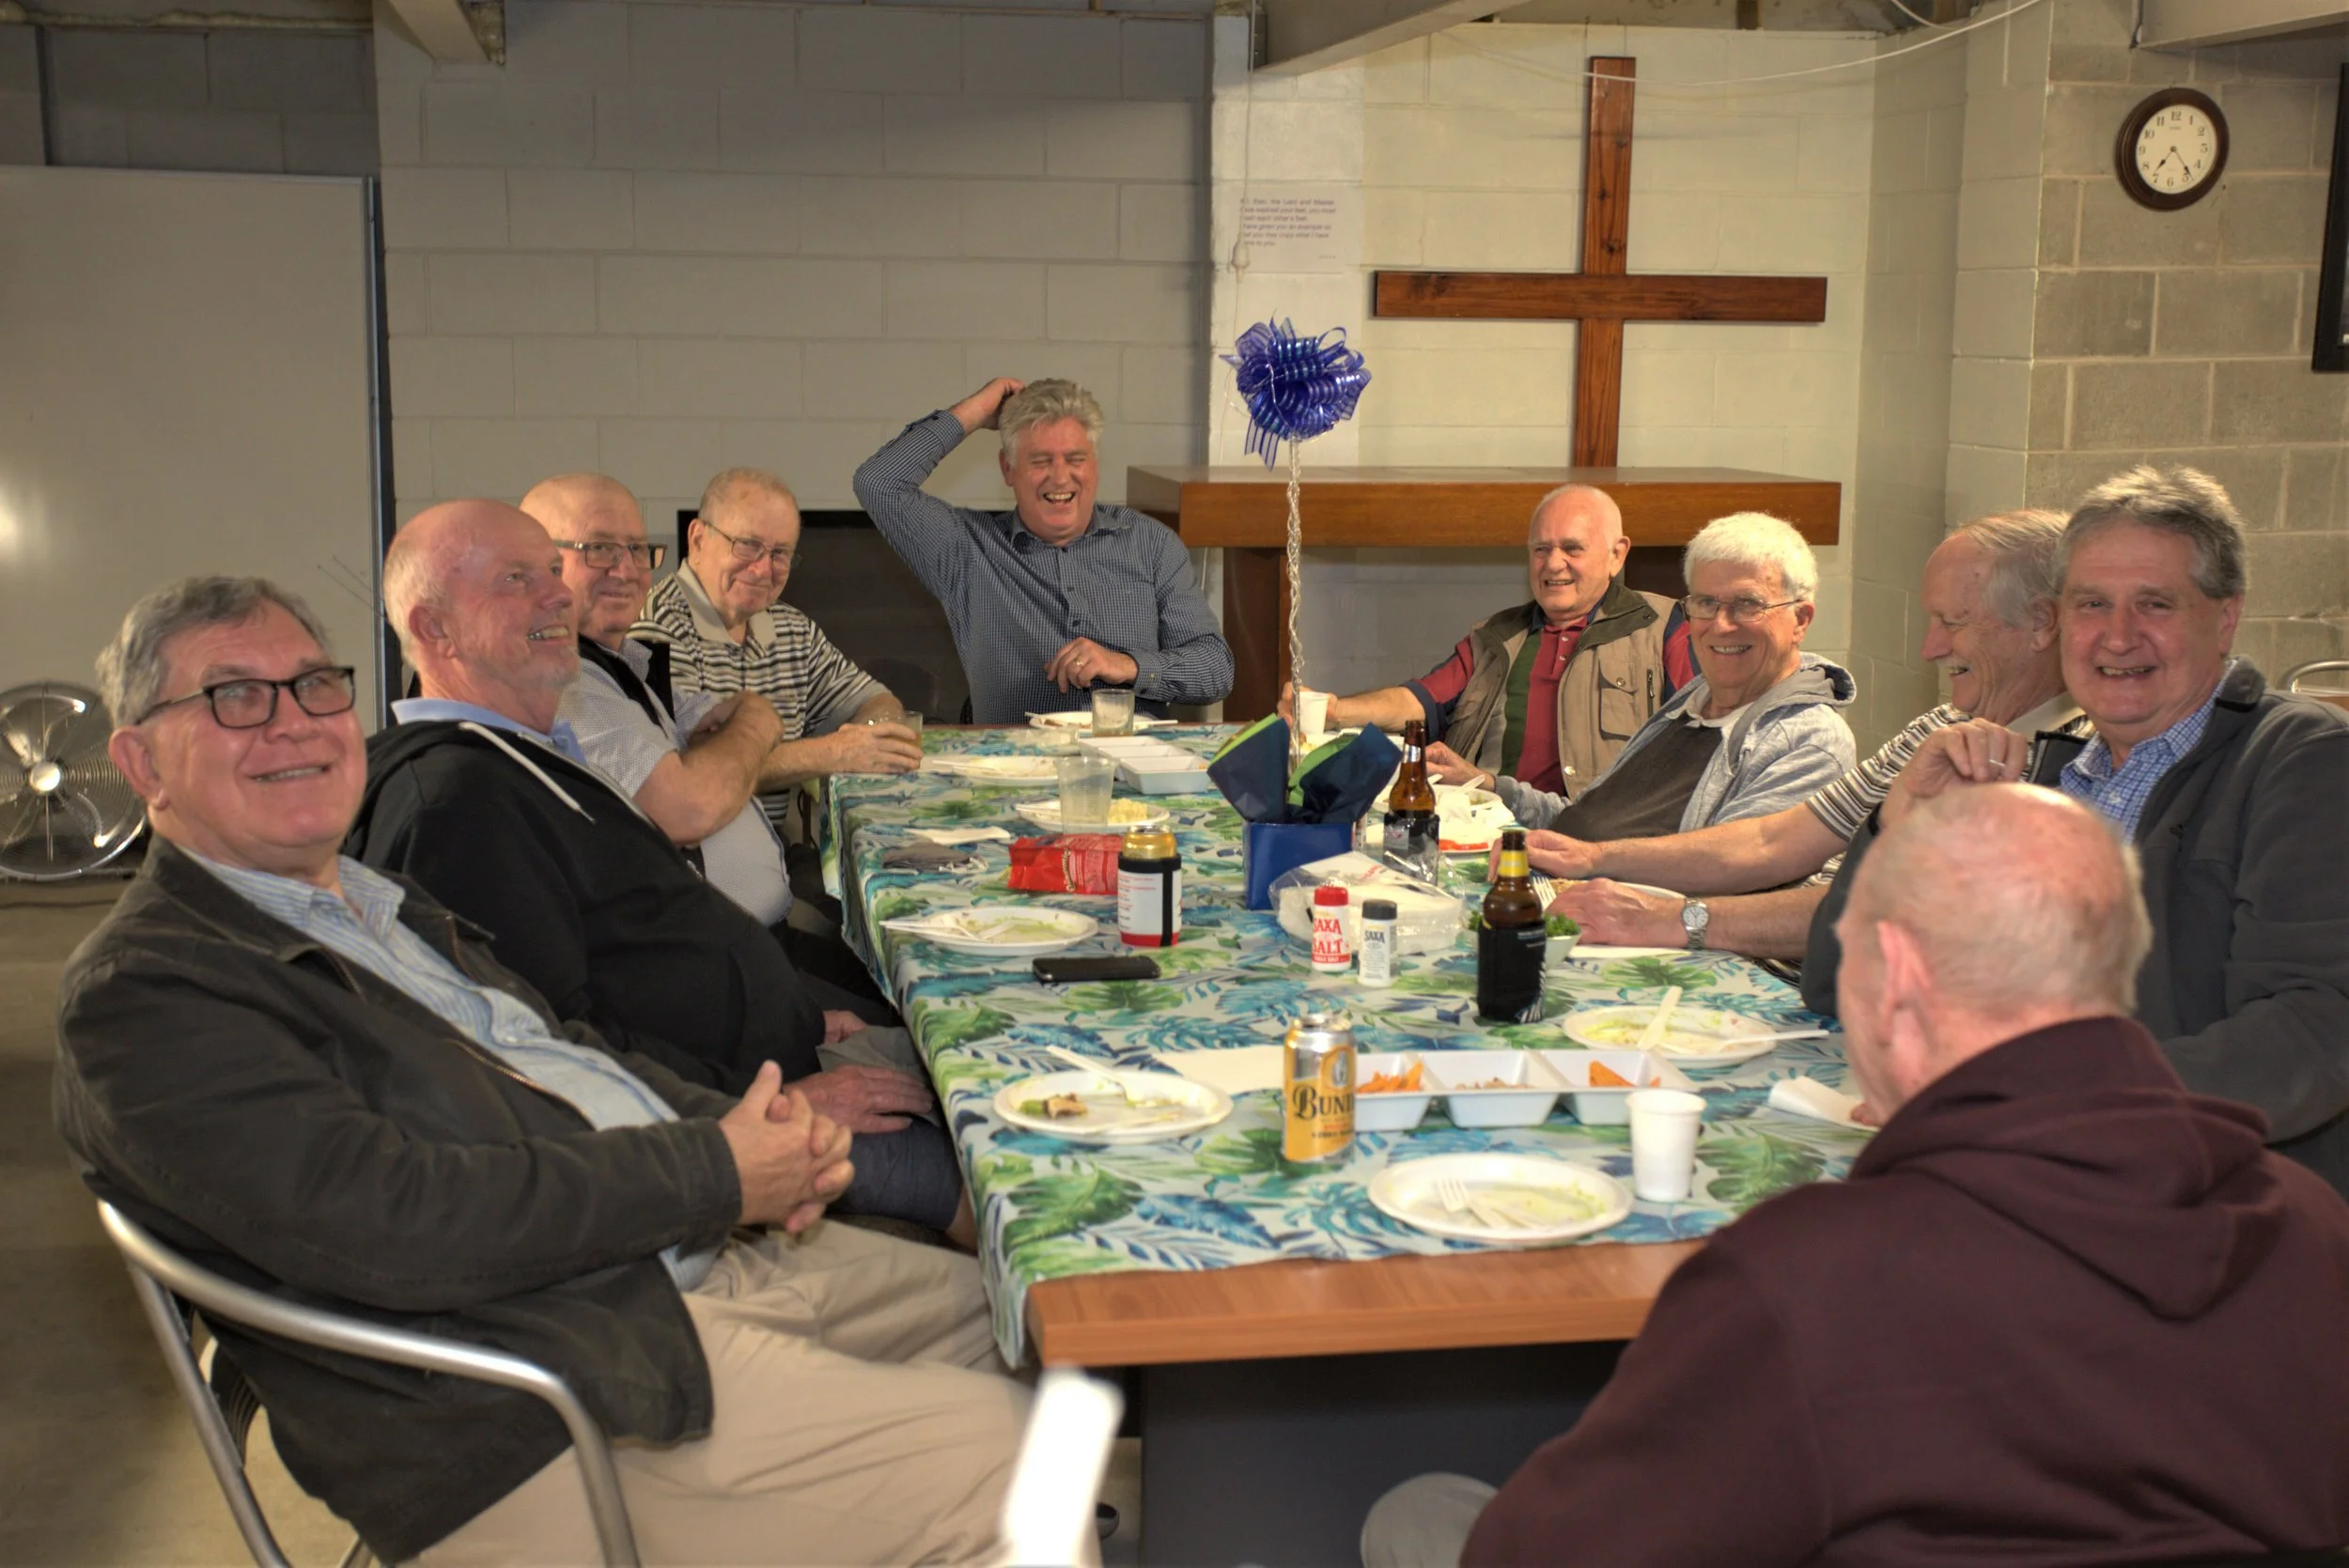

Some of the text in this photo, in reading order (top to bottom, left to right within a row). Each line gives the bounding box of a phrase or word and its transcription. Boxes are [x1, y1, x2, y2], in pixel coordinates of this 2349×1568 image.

[1313, 917, 1343, 936] SAXA
[1364, 929, 1385, 943] SAXA
[1312, 938, 1343, 955] SALT
